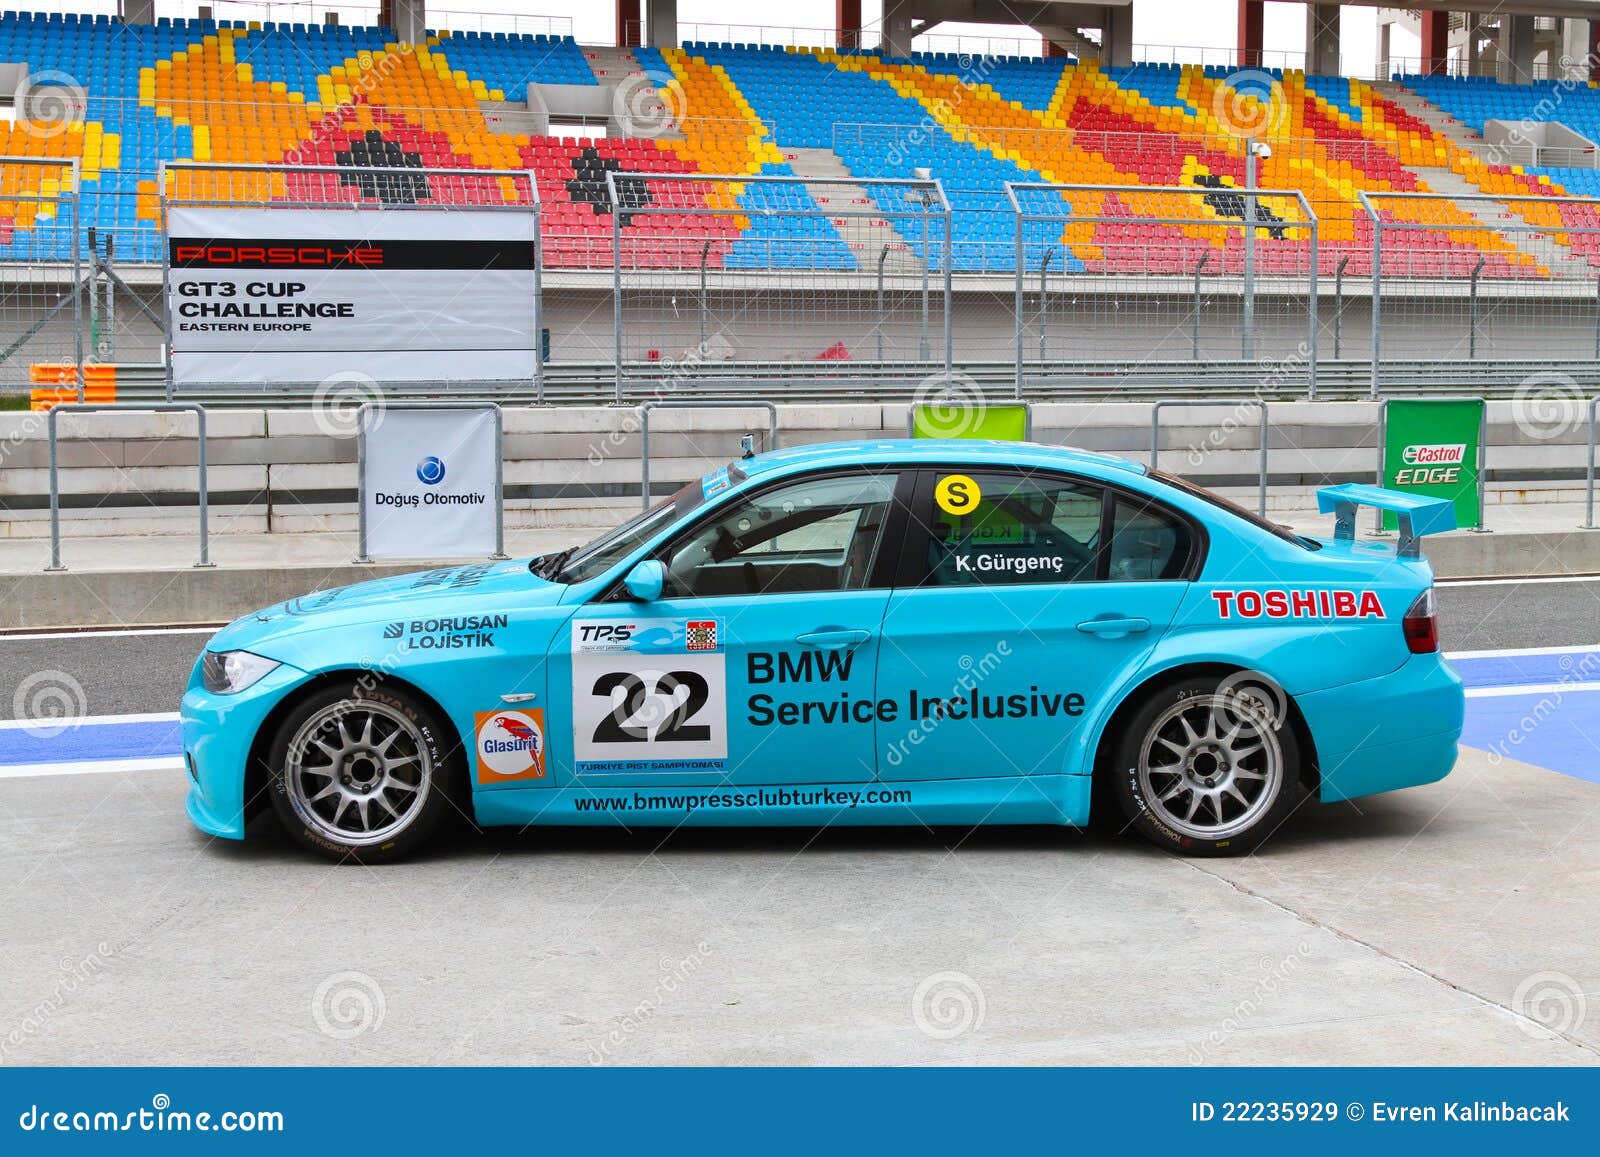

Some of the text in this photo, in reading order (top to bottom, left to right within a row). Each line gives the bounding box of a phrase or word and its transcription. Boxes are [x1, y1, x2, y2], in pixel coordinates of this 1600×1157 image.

[176, 246, 384, 264] PORSCHE
[178, 281, 306, 297] GT3 CUP
[178, 302, 355, 318] CHALLENGE
[179, 323, 312, 331] EASTERN EUROPE
[1417, 446, 1462, 462] Castrol
[1394, 467, 1462, 485] EDGE
[375, 492, 486, 508] Doğuş Otomotiv
[947, 482, 970, 507] S
[955, 553, 1064, 573] K.Gürgenç
[1211, 590, 1387, 619] TOSHIBA
[410, 614, 508, 634] BORUSAN
[408, 631, 495, 649] LOJİSTİK
[580, 625, 632, 642] TPS
[747, 650, 855, 685] BMW
[592, 670, 711, 744] 22
[747, 686, 1086, 727] Service Inclusive
[484, 736, 539, 755] Glasurit
[574, 787, 912, 813] www.bmwpressclubturkey.com
